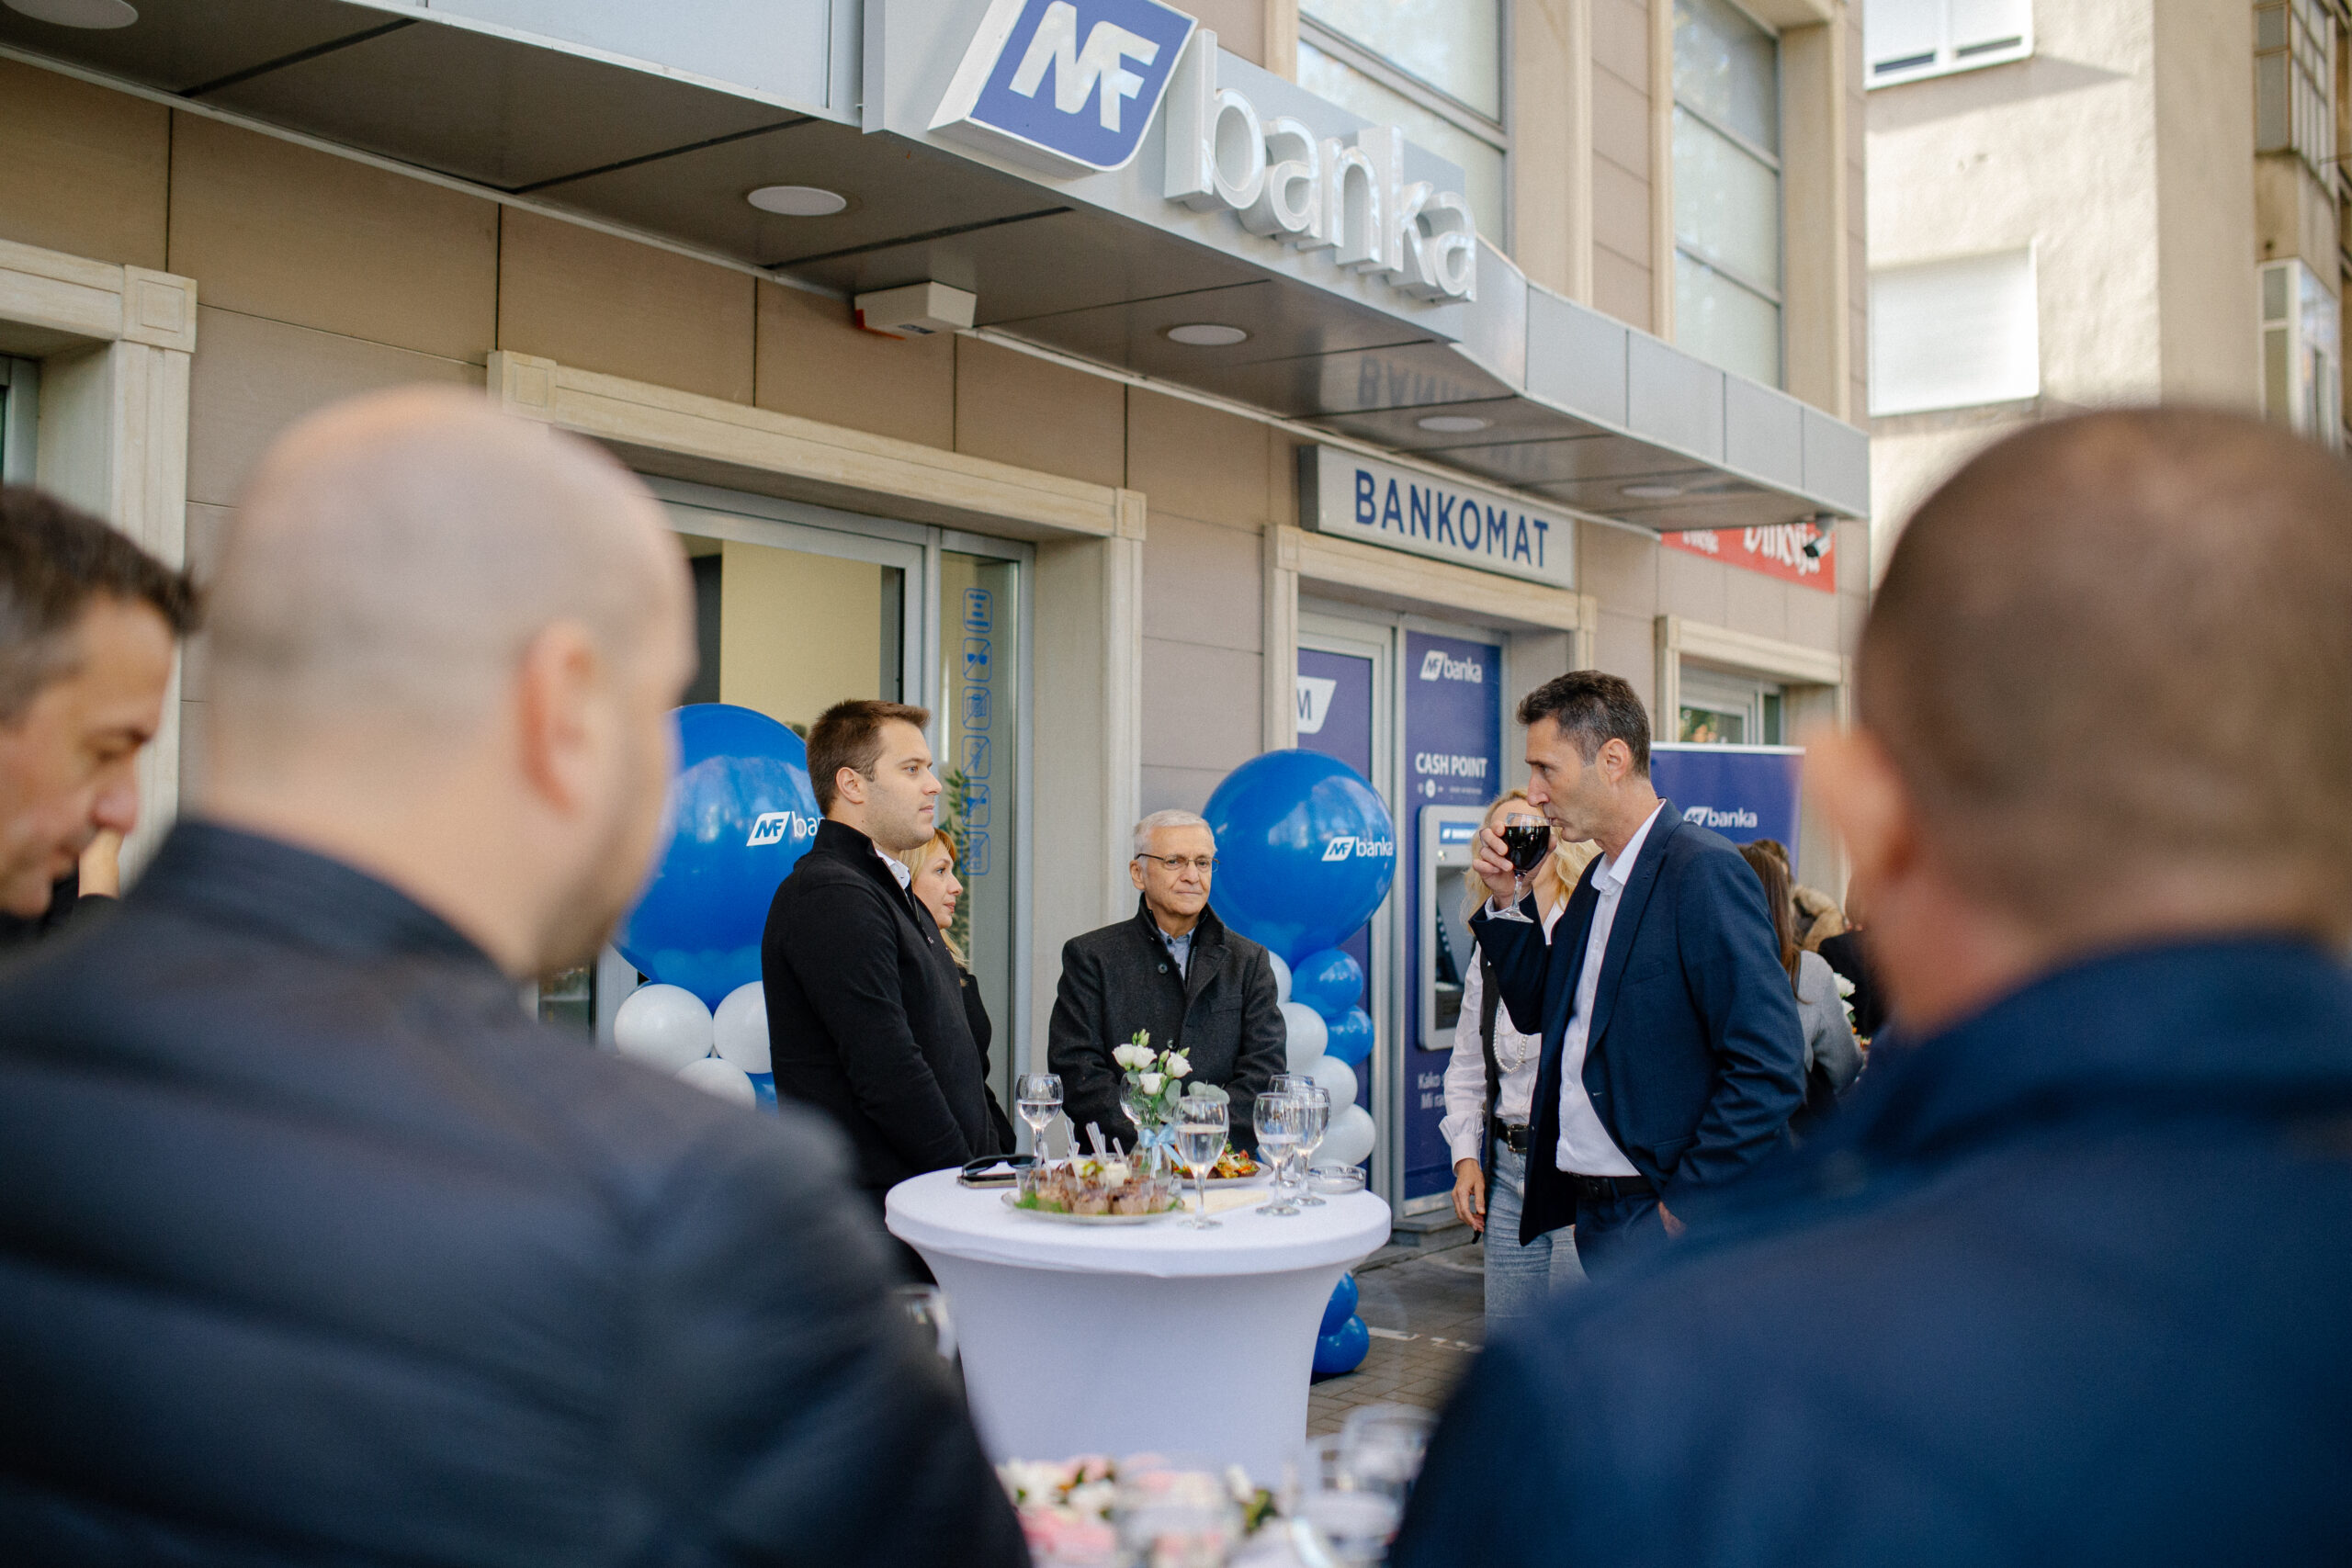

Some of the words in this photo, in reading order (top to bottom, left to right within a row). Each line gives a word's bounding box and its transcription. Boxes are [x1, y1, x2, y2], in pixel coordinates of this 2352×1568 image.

[1167, 28, 1477, 303] banka
[1355, 468, 1549, 568] BANKOMAT
[1443, 652, 1483, 684] banka
[1415, 752, 1449, 776] CASH
[1451, 755, 1487, 779] POINT
[1707, 807, 1758, 829] banka
[1356, 836, 1393, 857] banka
